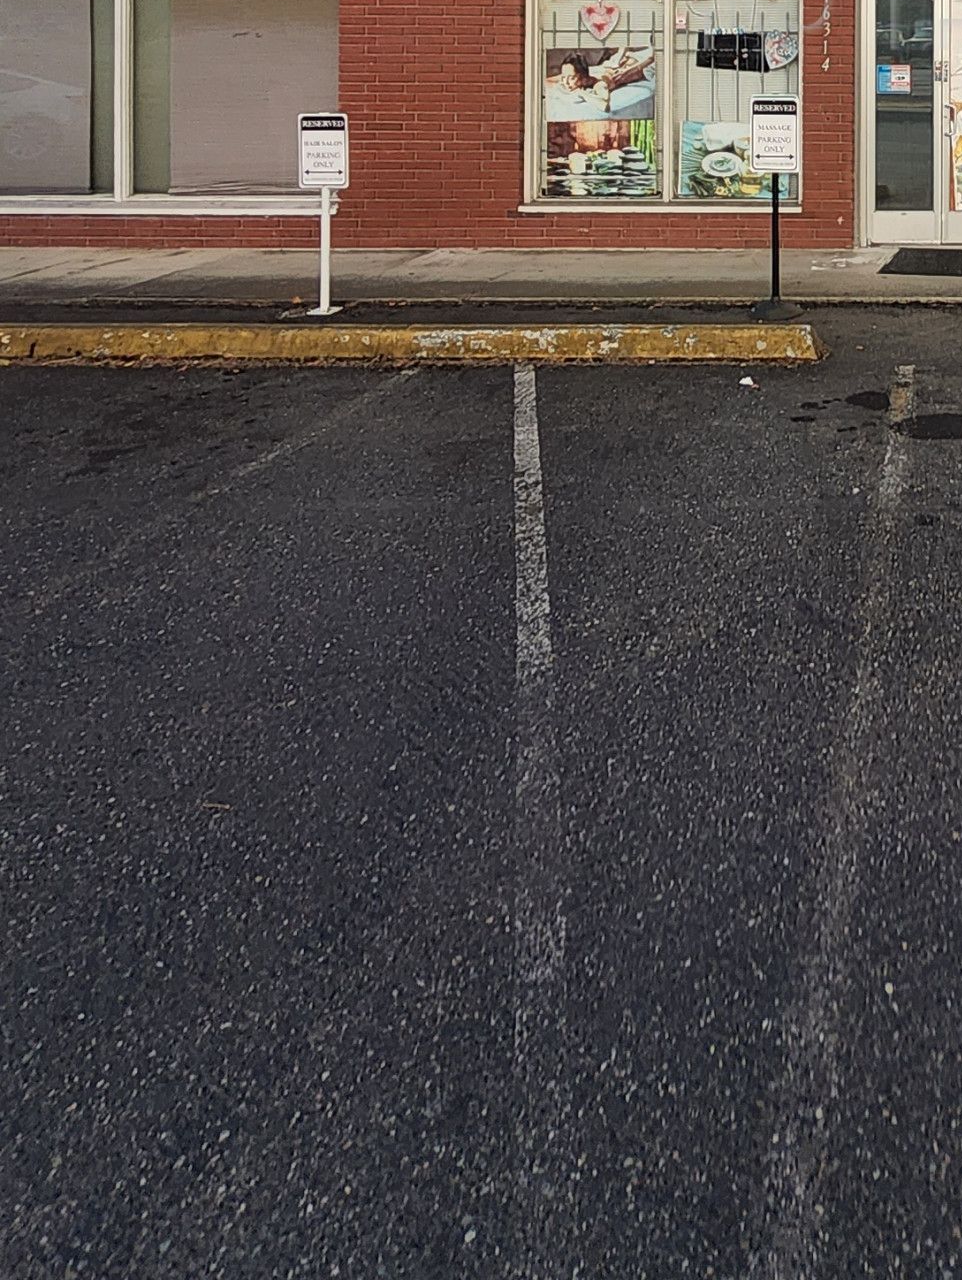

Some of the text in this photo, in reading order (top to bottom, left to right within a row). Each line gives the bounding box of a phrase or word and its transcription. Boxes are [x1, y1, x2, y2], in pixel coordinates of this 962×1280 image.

[754, 104, 796, 112] RESERVED
[302, 120, 344, 128] RESERVED
[757, 136, 792, 144] PARKING
[763, 145, 785, 153] ONLY
